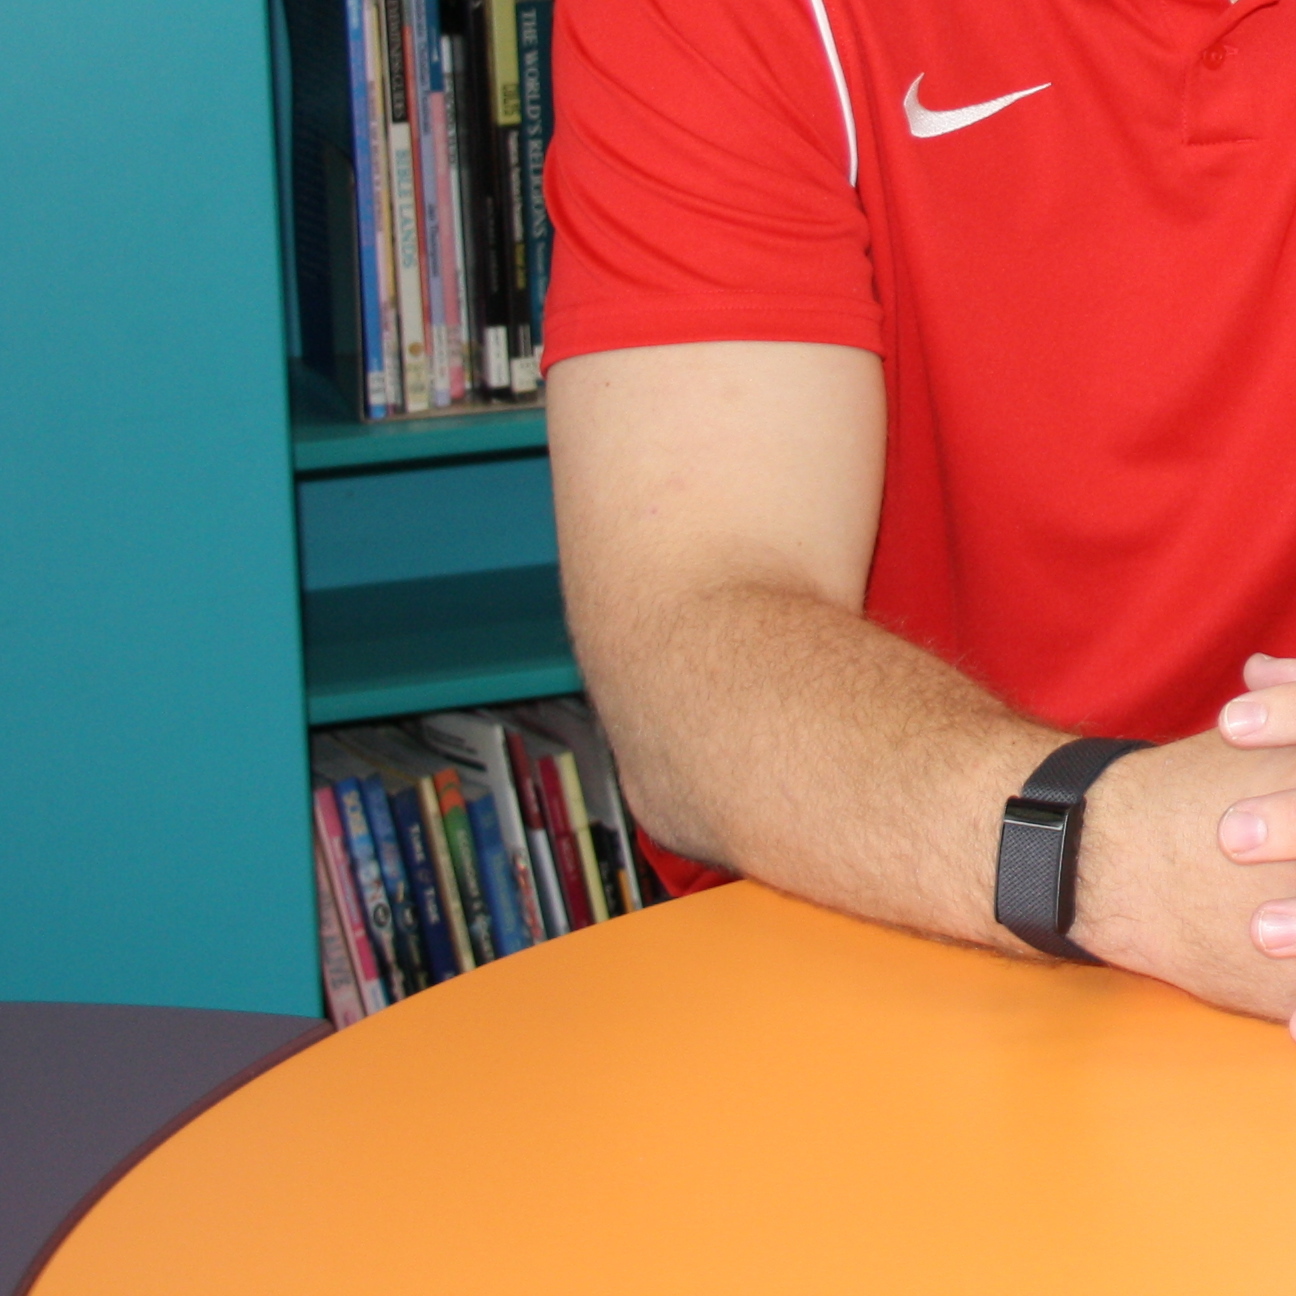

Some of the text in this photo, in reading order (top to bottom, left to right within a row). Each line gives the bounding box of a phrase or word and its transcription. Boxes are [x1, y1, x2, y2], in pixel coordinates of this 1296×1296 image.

[393, 148, 416, 268] BIBLE LANDS
[521, 8, 549, 238] THE WORLD'S RELIGIONS
